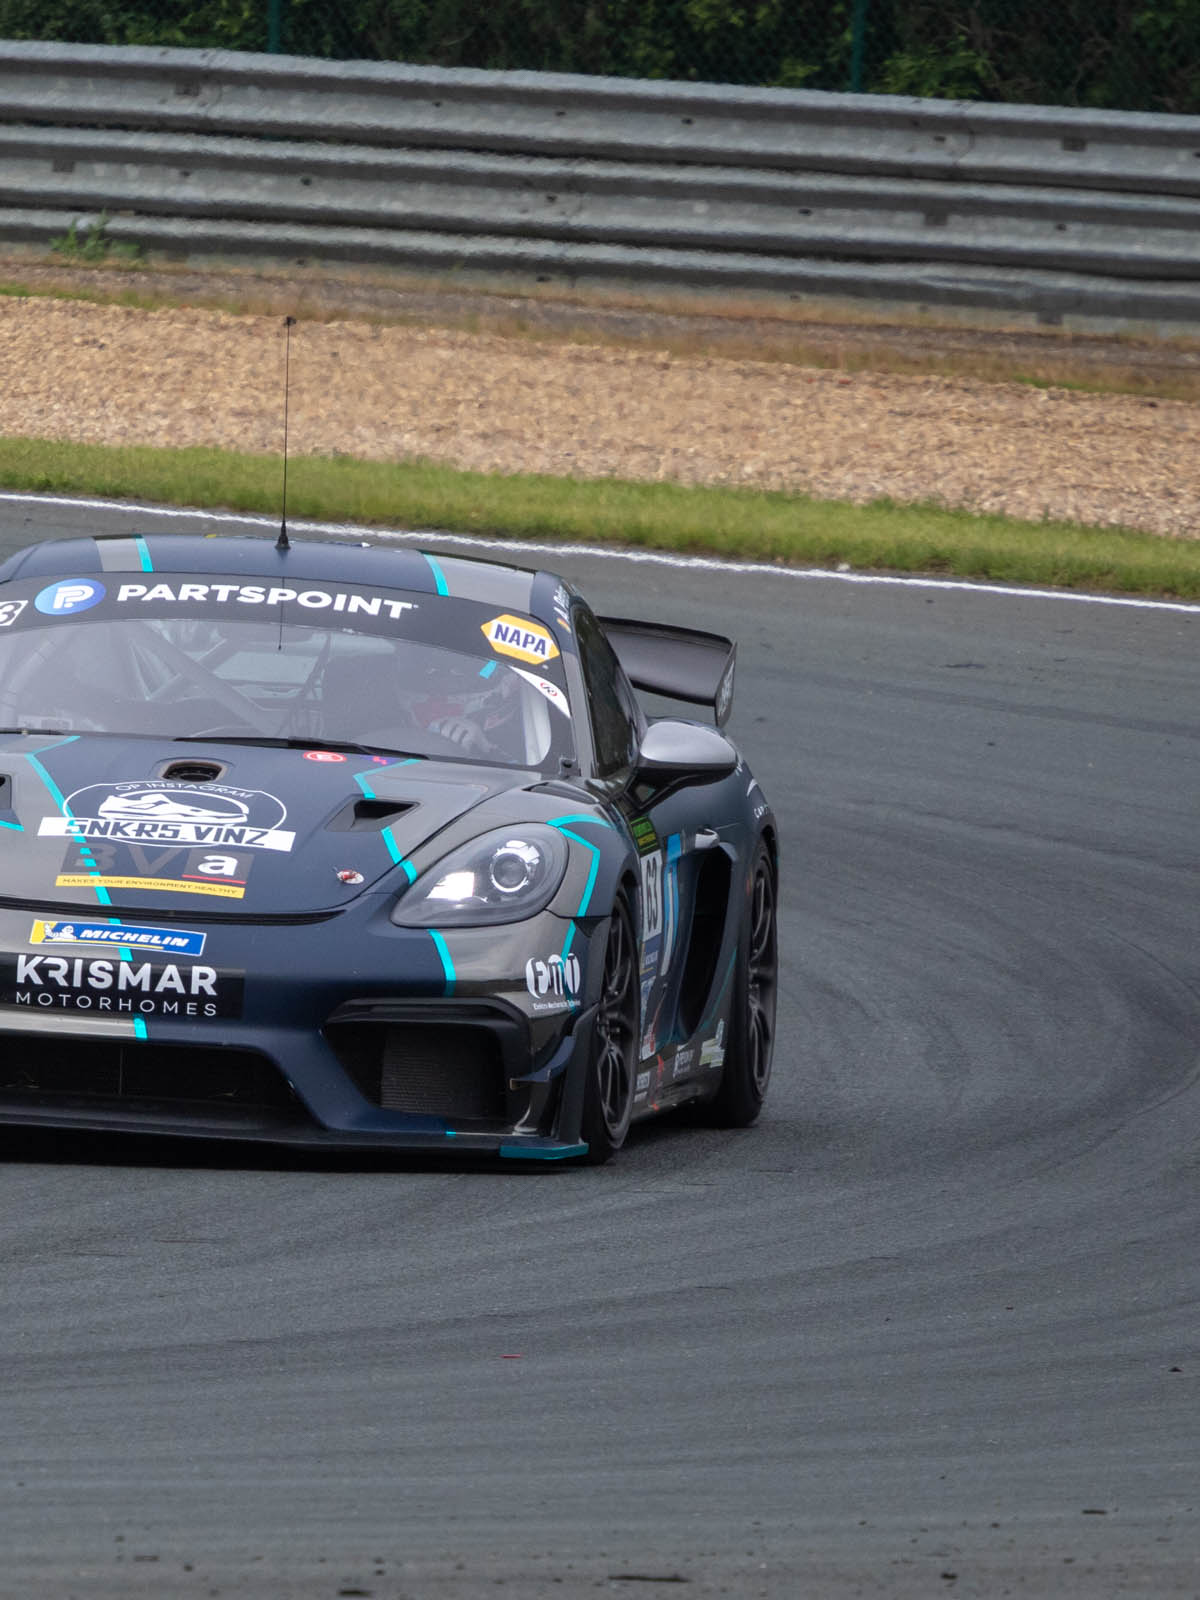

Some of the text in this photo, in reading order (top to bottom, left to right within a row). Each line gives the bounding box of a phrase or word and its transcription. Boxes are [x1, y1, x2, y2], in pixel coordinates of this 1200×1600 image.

[117, 584, 412, 619] PARTSPOINT
[494, 623, 547, 656] NAPA
[115, 782, 255, 798] OP INSTAGRAM
[125, 878, 193, 890] ENVIRONMENT
[80, 929, 190, 947] MICHELIN
[16, 954, 218, 996] KRISMAR
[16, 992, 217, 1016] MOTORHOMES
